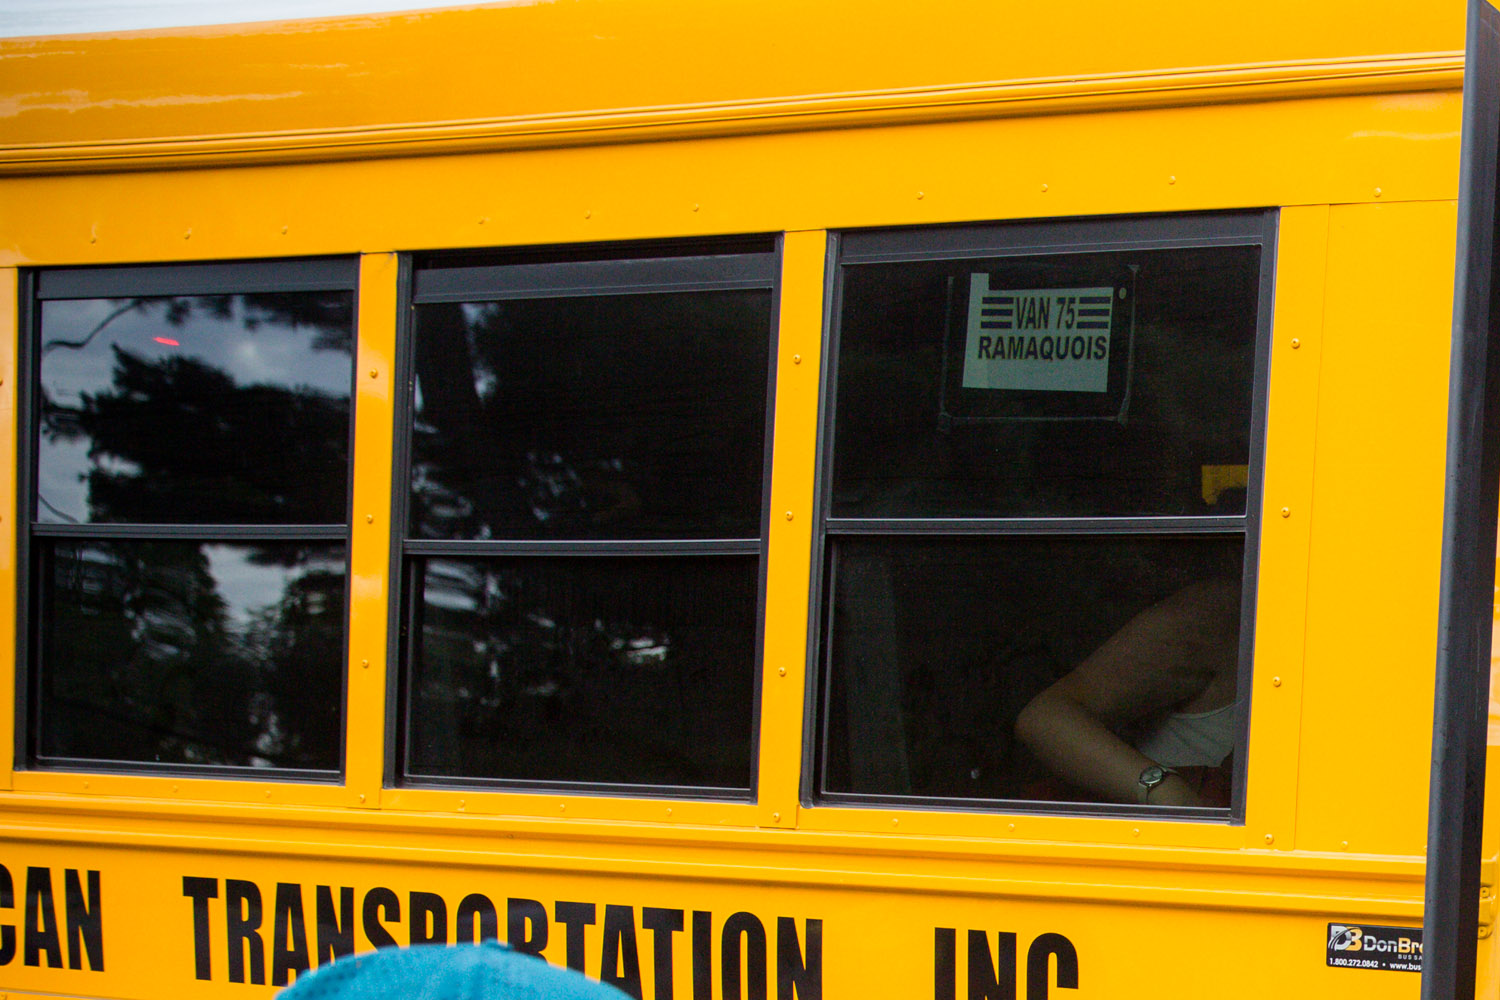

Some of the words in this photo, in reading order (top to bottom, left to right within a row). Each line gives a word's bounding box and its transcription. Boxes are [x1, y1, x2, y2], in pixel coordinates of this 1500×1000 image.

[1016, 297, 1050, 329] VAN
[1056, 297, 1076, 329] 75
[978, 336, 1107, 360] RAMAQUOIS
[1329, 957, 1378, 967] 1.800.272.0842
